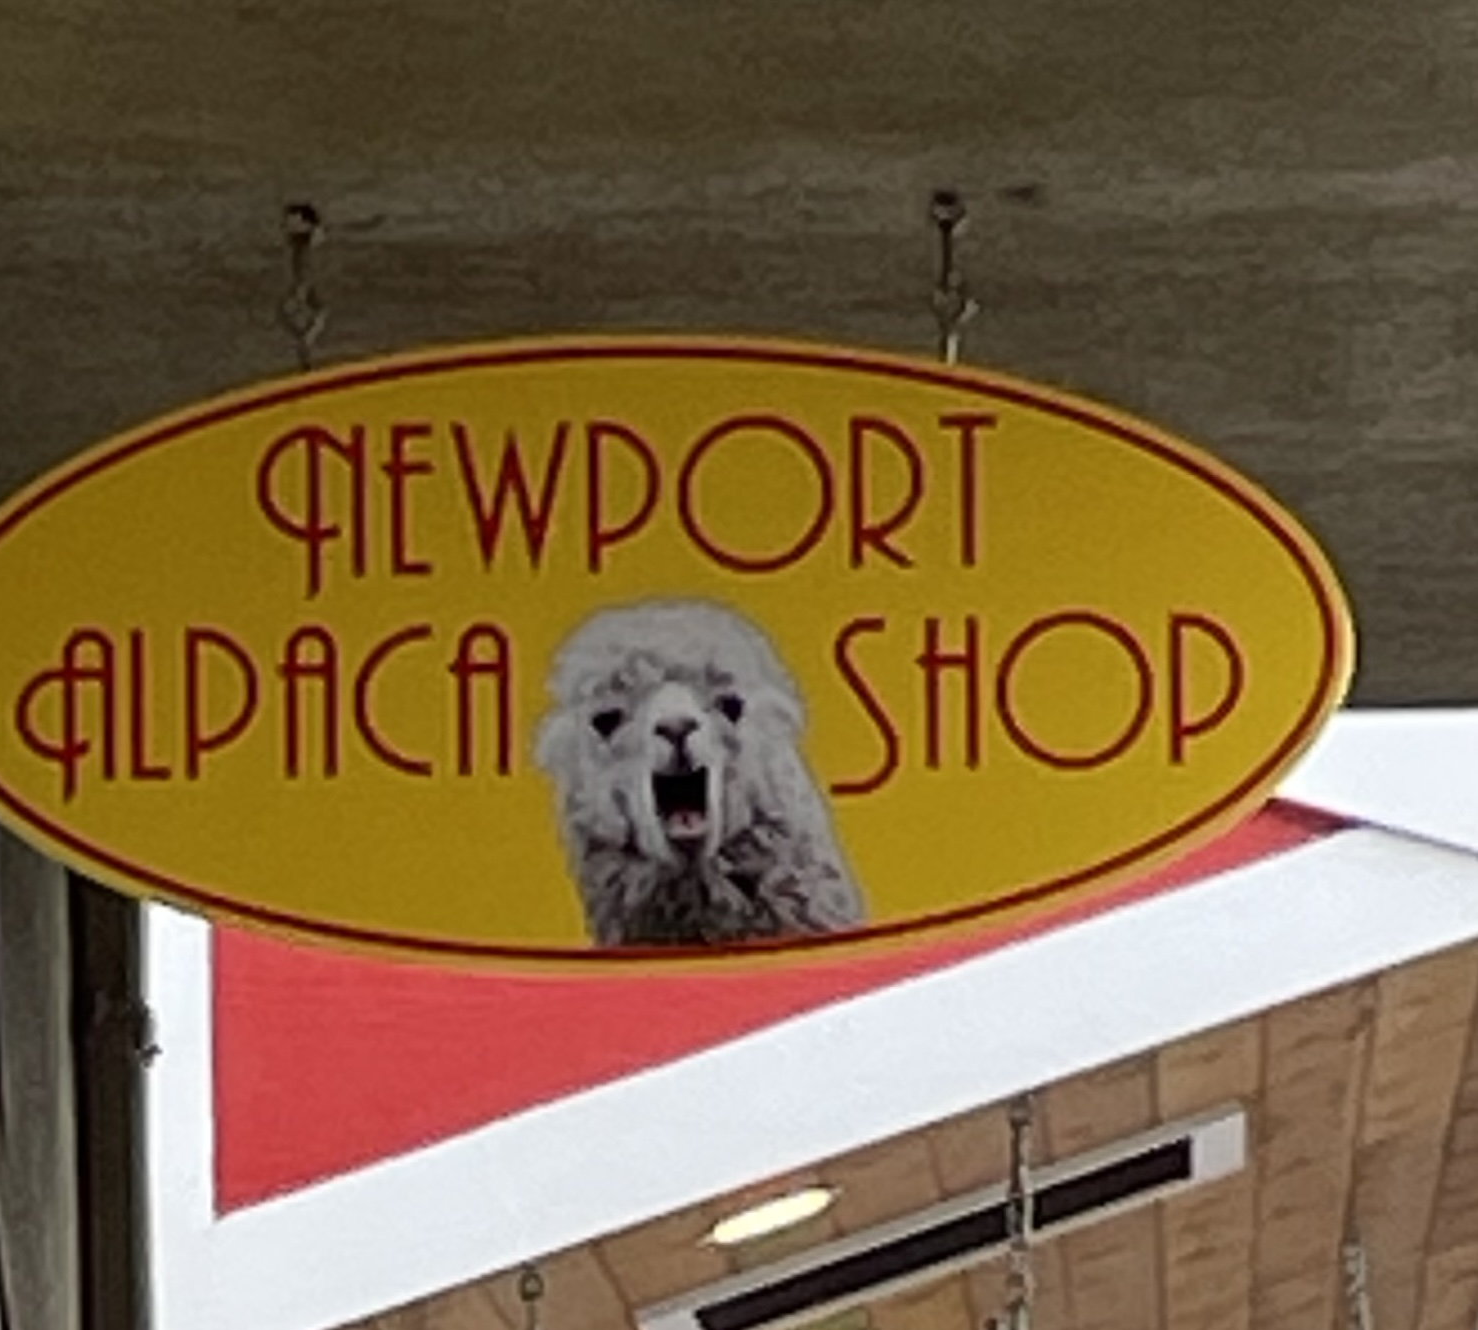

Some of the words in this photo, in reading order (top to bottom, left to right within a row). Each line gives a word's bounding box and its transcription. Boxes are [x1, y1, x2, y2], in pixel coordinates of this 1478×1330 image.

[257, 414, 997, 596] NEWPORT
[14, 621, 511, 801] ALPACA
[831, 611, 1245, 795] SHOP
